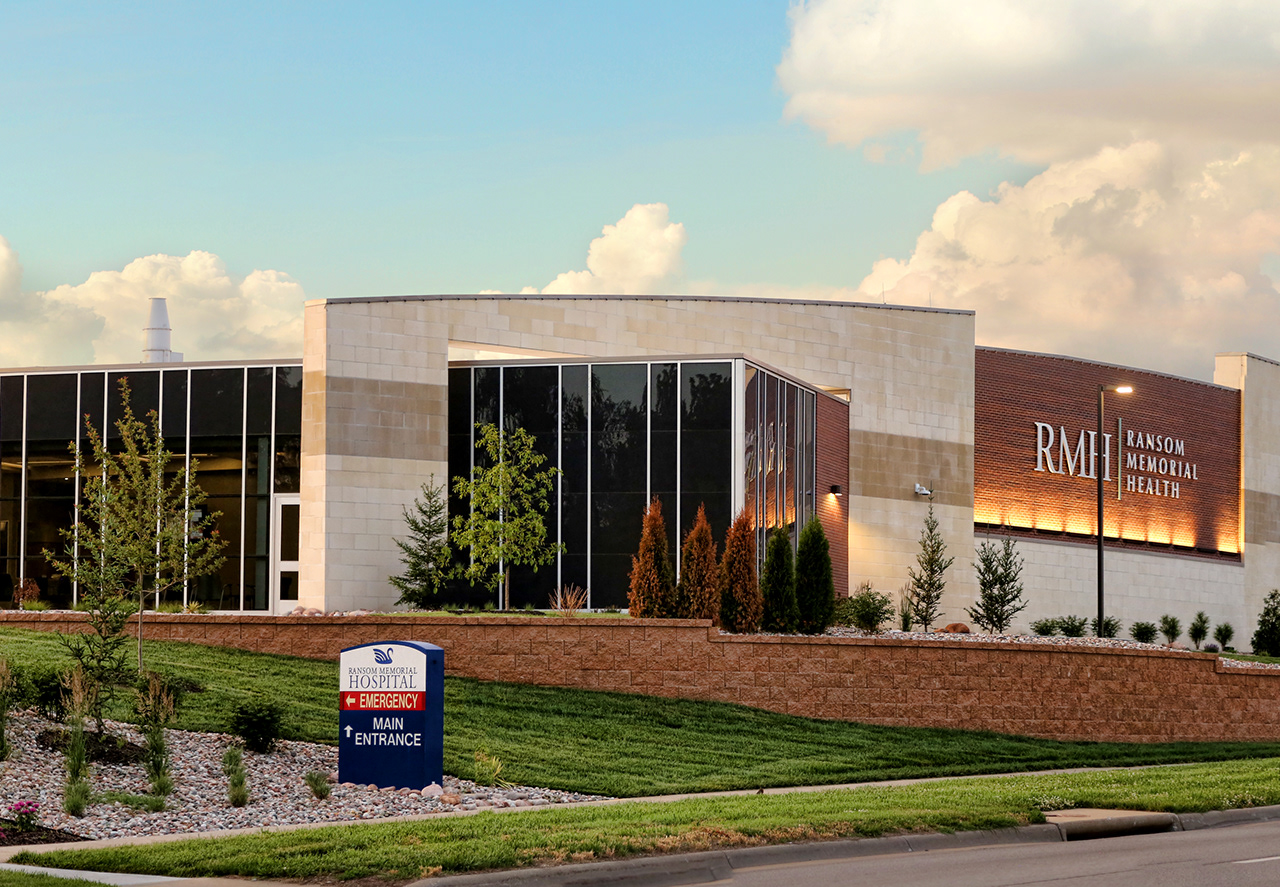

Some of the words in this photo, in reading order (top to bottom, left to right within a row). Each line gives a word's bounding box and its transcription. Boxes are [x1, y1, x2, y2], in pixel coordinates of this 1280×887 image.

[1126, 429, 1185, 456] RANSOM
[1034, 421, 1112, 481] RMH
[1126, 452, 1198, 480] MEMORIAL
[1126, 474, 1180, 499] HEALTH
[348, 667, 378, 675] RANSOM
[379, 667, 418, 675] MEMORIAL
[349, 675, 417, 689] HOSPITAL
[359, 693, 419, 708] EMERGENCY
[373, 717, 404, 730] MAIN
[355, 733, 422, 746] ENTRANCE
